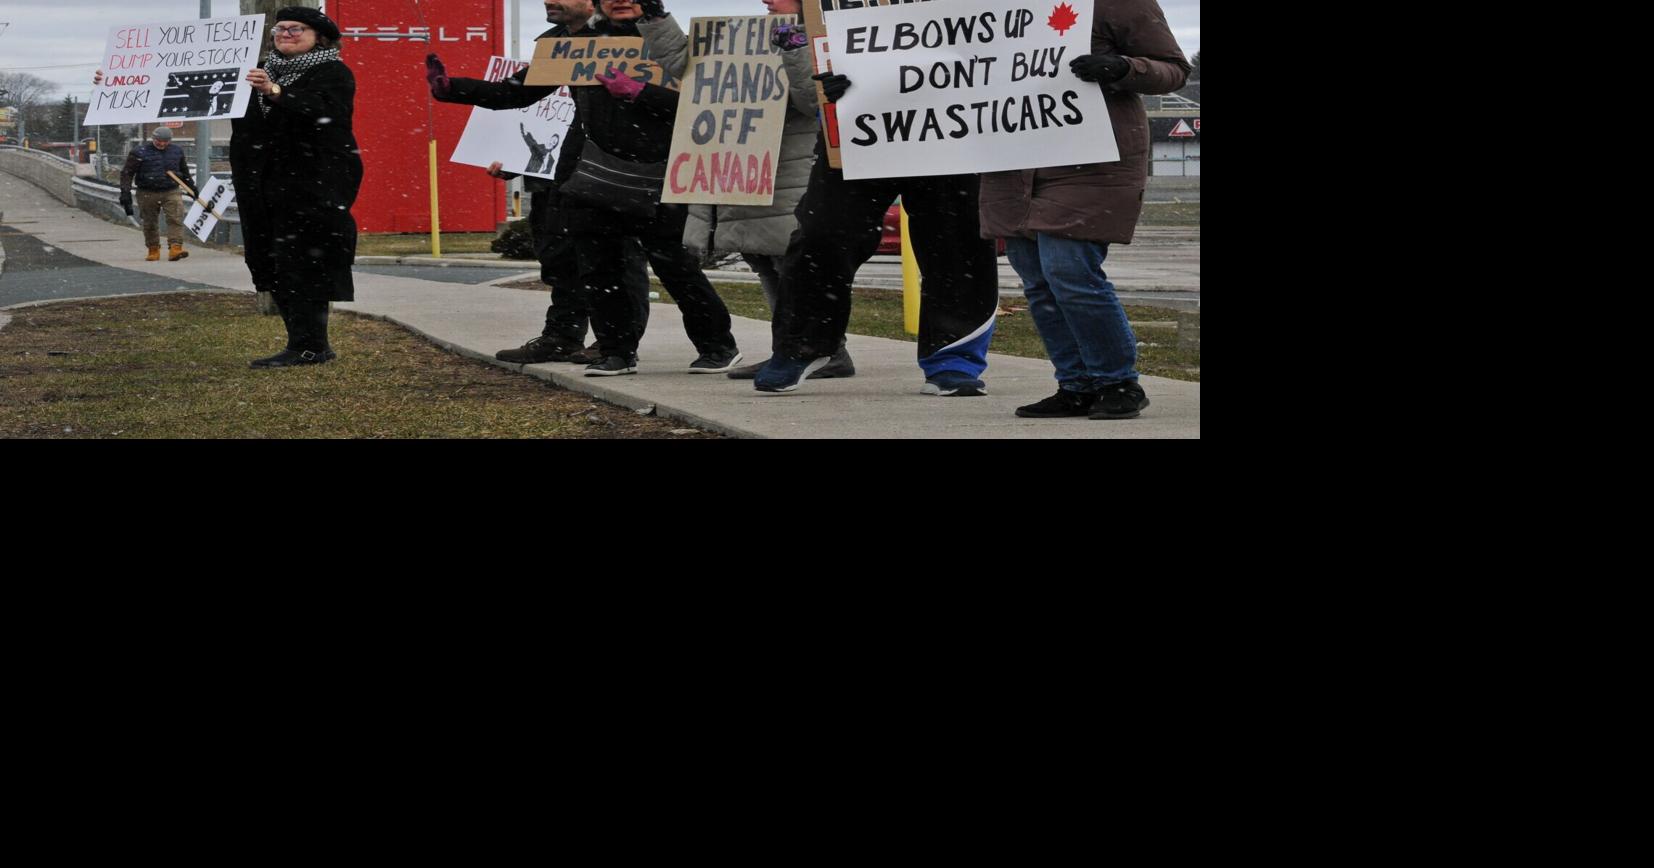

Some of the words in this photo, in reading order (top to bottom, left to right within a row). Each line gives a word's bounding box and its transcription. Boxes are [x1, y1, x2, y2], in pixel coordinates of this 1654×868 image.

[116, 28, 150, 48] SELL
[158, 25, 195, 45] YOUR
[205, 20, 257, 43] TESLA!
[345, 27, 488, 42] TESLA
[693, 19, 743, 57] HEY
[745, 17, 796, 56] ELO
[846, 12, 997, 54] ELBOWS
[1004, 9, 1033, 38] UP
[109, 53, 153, 70] DUMP
[156, 51, 194, 67] YOUR
[197, 47, 249, 66] STOCK!
[899, 55, 997, 93] DON'T
[1011, 46, 1066, 82] BUY
[97, 90, 150, 110] MUSK!
[105, 75, 150, 87] UNLOAD
[692, 61, 785, 104] HANDS
[691, 108, 764, 145] OFF
[851, 90, 1084, 146] SWASTICARS
[669, 151, 773, 195] CANADA
[191, 185, 225, 235] OLIGARCH
